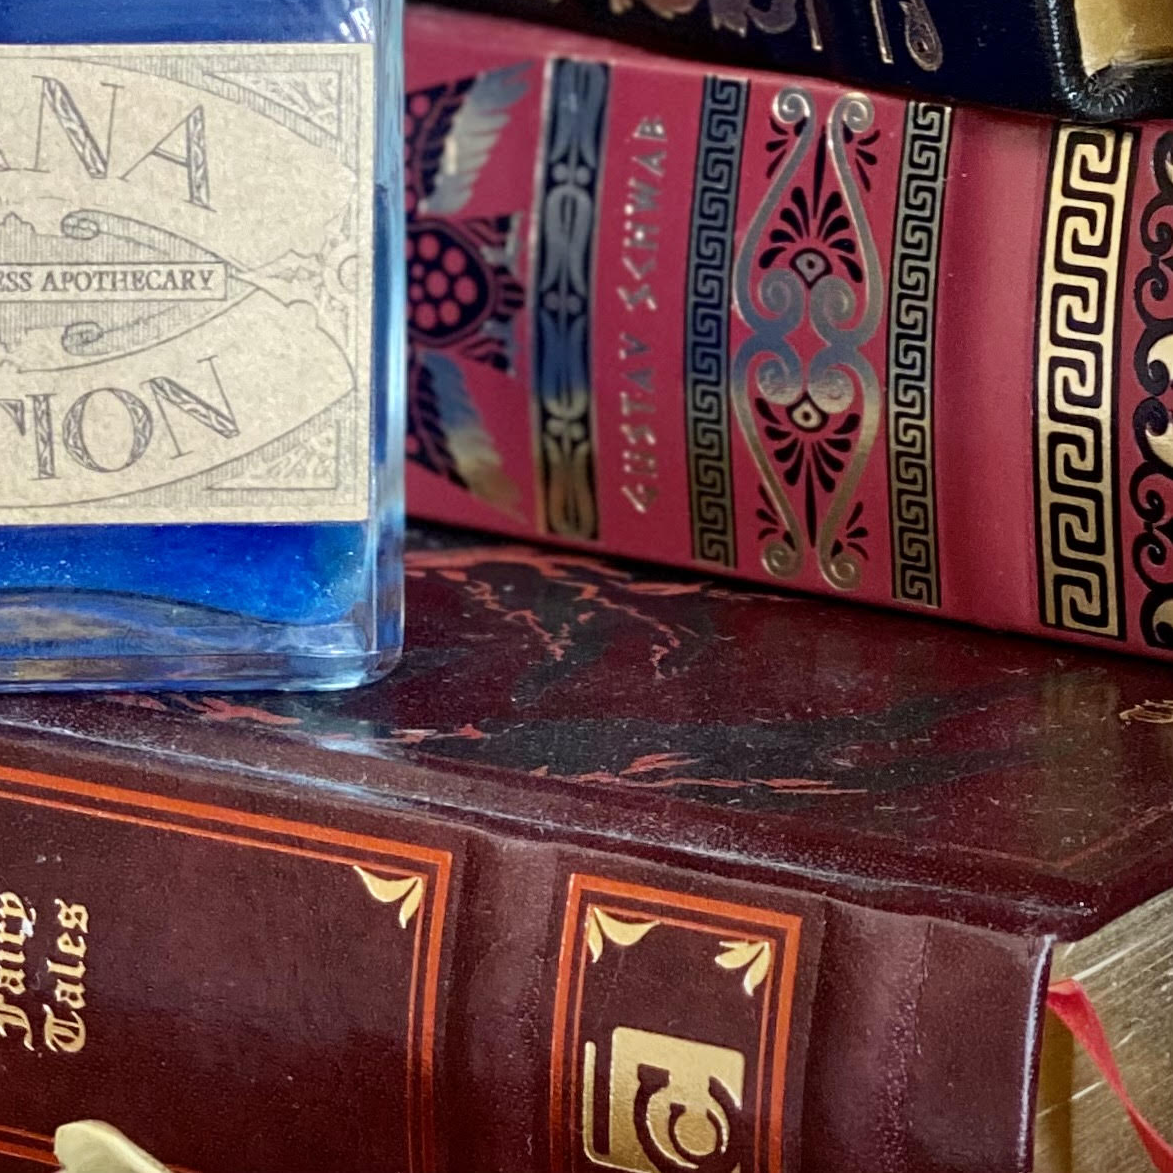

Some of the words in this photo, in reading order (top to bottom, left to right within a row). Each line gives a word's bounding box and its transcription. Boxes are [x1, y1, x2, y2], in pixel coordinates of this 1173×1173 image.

[40, 268, 215, 292] APOTHECARY
[617, 115, 668, 312] SCHWAB
[618, 331, 659, 514] GUSTAV
[42, 897, 90, 1053] Tales
